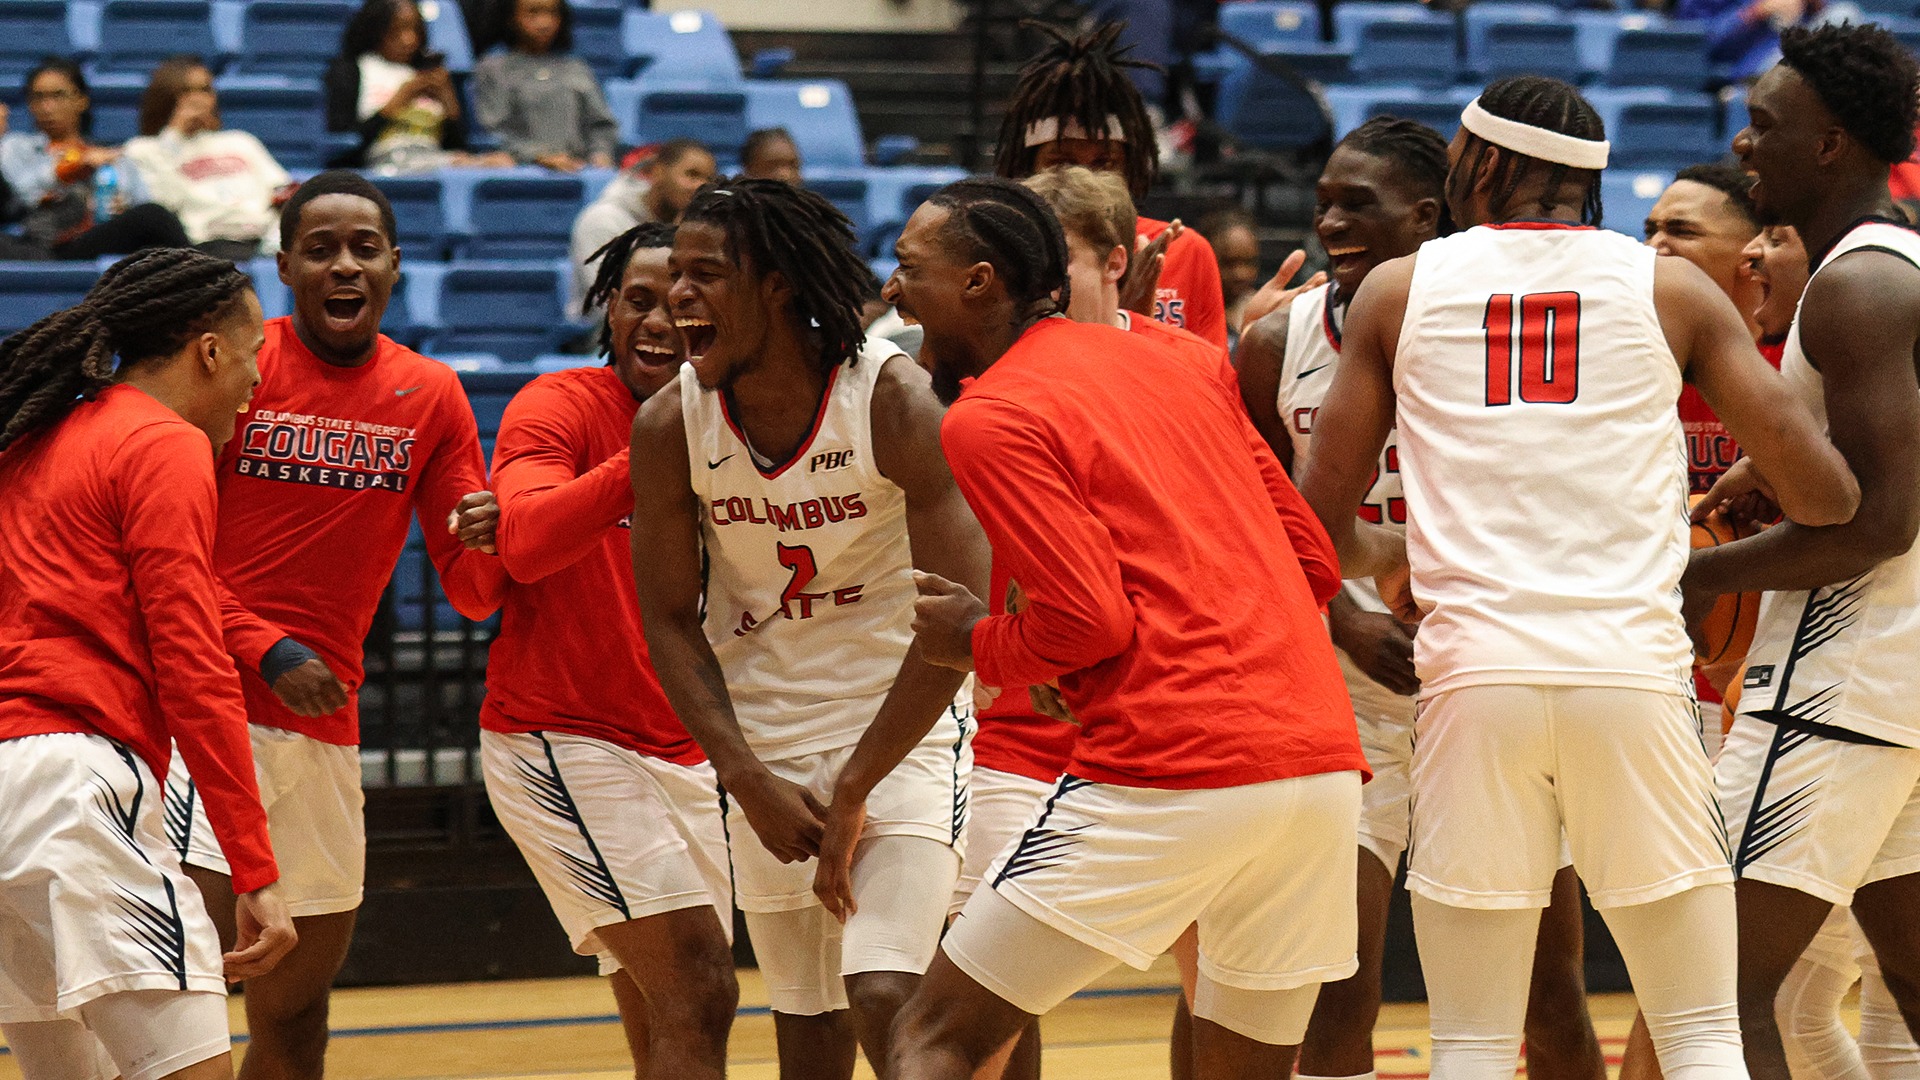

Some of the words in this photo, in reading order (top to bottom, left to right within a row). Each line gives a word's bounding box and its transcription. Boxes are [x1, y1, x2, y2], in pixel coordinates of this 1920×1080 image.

[1482, 291, 1581, 407] 10
[255, 409, 317, 426] COLUMBUS
[317, 416, 353, 431] STATE
[354, 419, 417, 438] UNIVERSITY
[1293, 406, 1320, 435] C
[240, 421, 418, 472] COUGARS
[810, 449, 855, 473] PBC
[238, 458, 405, 492] BASKETBALL
